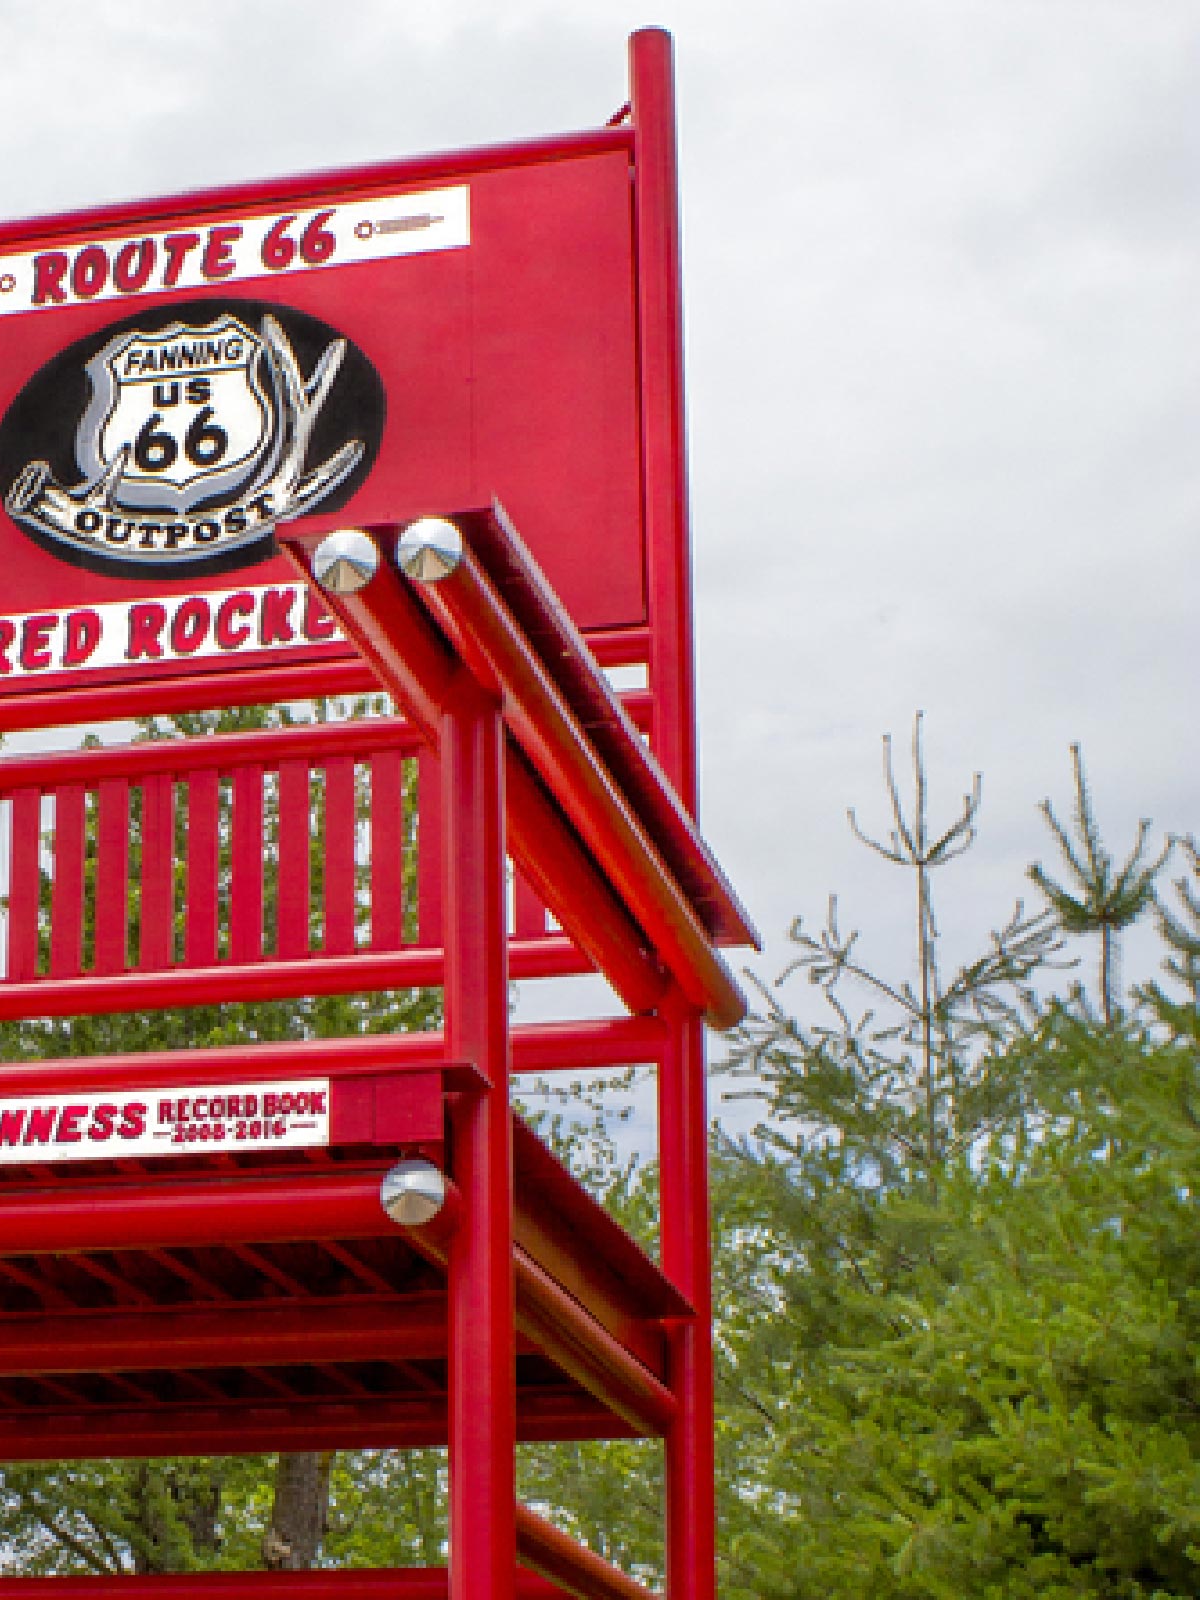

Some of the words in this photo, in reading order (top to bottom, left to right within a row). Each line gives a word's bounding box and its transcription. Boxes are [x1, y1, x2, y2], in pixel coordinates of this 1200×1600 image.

[31, 224, 243, 306] ROUTE
[260, 208, 337, 271] 66
[122, 337, 245, 375] FANNING
[152, 377, 212, 408] US
[133, 405, 229, 471] 66
[74, 492, 275, 549] OUTPOST
[124, 586, 337, 662] ROCKE
[157, 1094, 258, 1125] RECORD
[262, 1089, 327, 1118] BOOK
